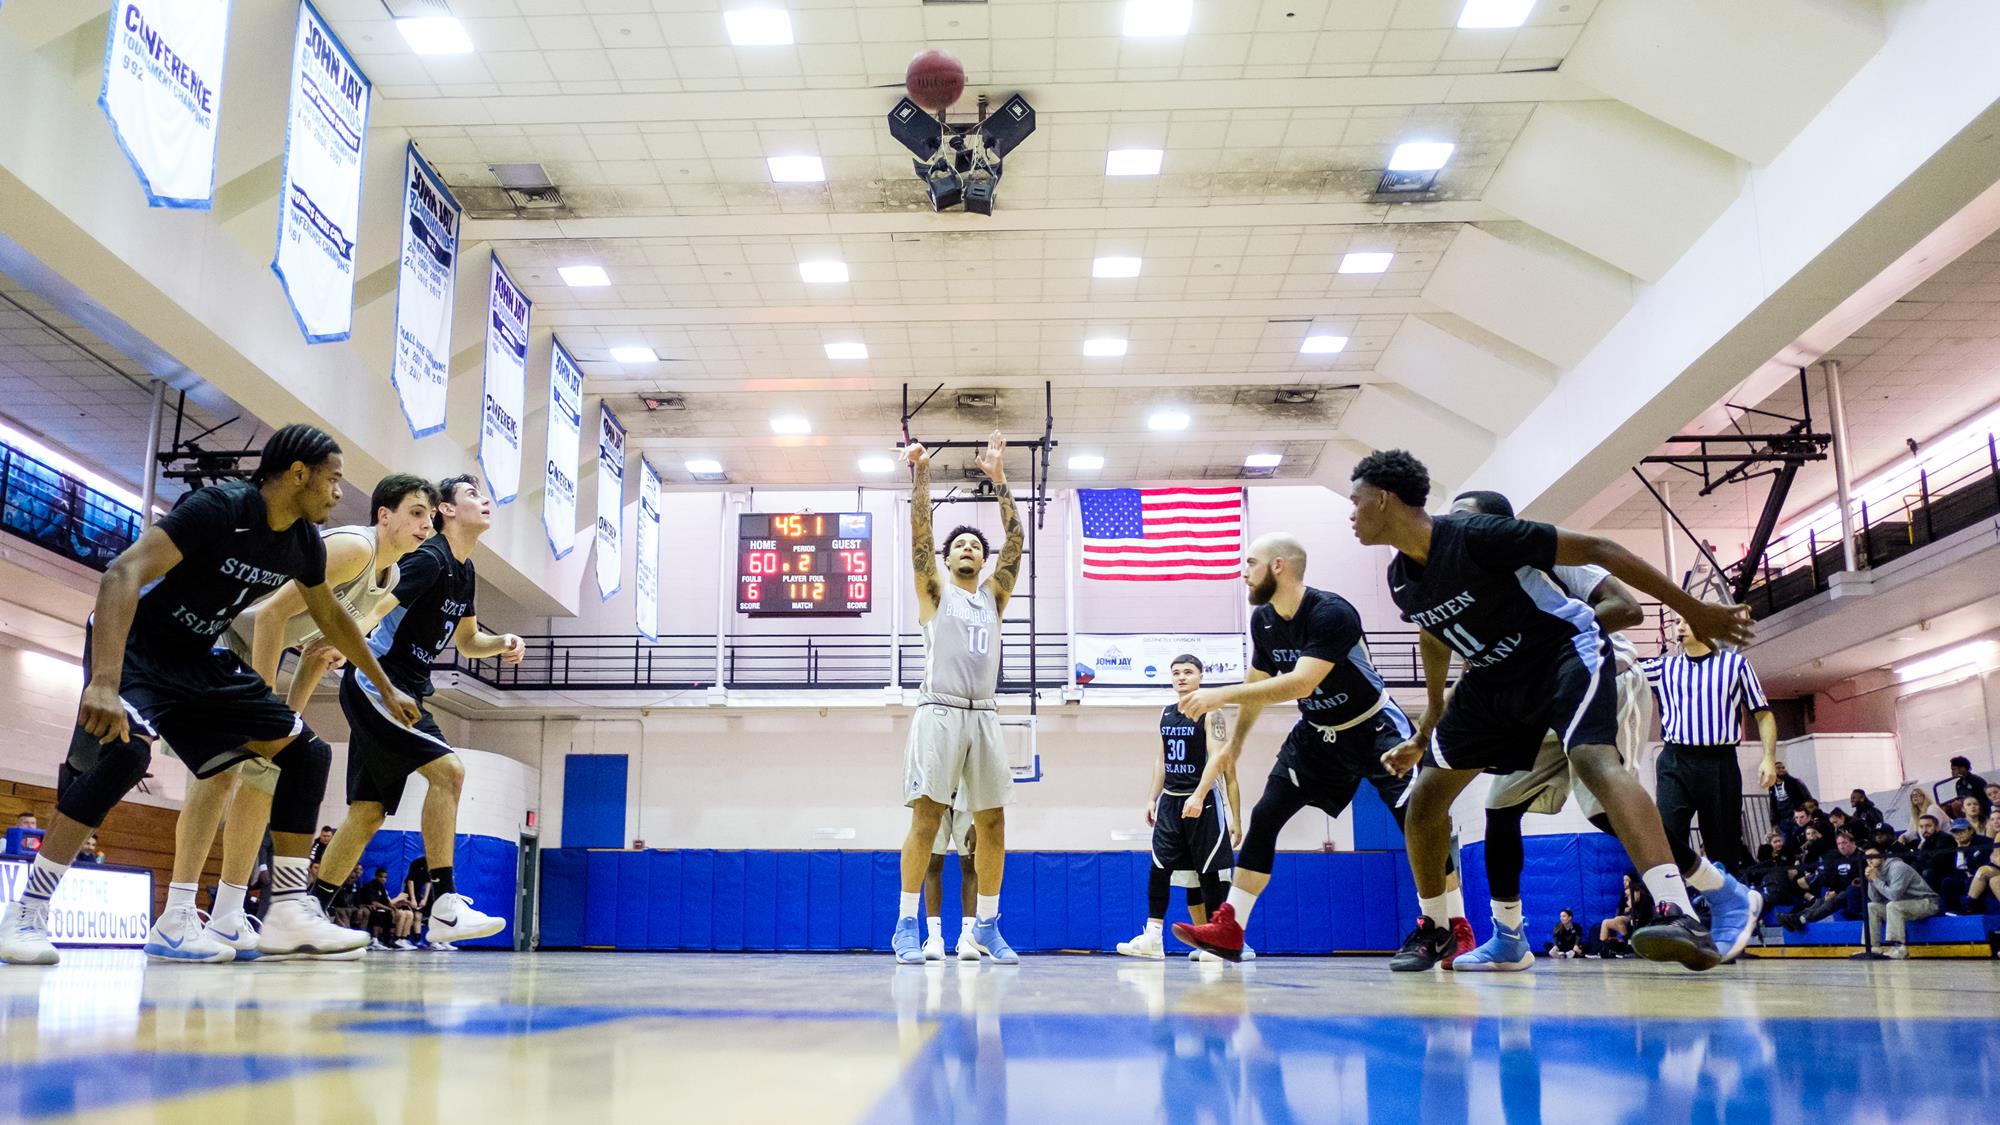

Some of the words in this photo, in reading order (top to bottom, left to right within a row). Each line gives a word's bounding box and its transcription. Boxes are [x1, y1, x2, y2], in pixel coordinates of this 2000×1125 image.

[305, 18, 340, 86] JOHN
[340, 67, 362, 111] JAY
[775, 515, 824, 537] 45.1
[750, 540, 777, 550] HOME
[792, 545, 815, 553] PERIOD
[831, 539, 861, 549] GUEST
[749, 552, 776, 573] 60
[798, 554, 811, 572] 2
[840, 552, 865, 573] 75
[741, 575, 762, 583] FOULS
[782, 575, 807, 583] PLAYER
[808, 575, 825, 583] FOUL
[847, 575, 867, 583] FOULS
[747, 583, 759, 600] 6
[849, 582, 865, 599] 10
[740, 602, 761, 610] SCORE
[1409, 590, 1476, 628] STATEN
[435, 620, 455, 650] 3
[967, 626, 989, 655] 10
[1442, 623, 1486, 658] 11
[1095, 657, 1117, 666] JOHN
[1118, 657, 1132, 666] JAY
[1161, 726, 1195, 736] STATEN
[1167, 739, 1186, 760] 30
